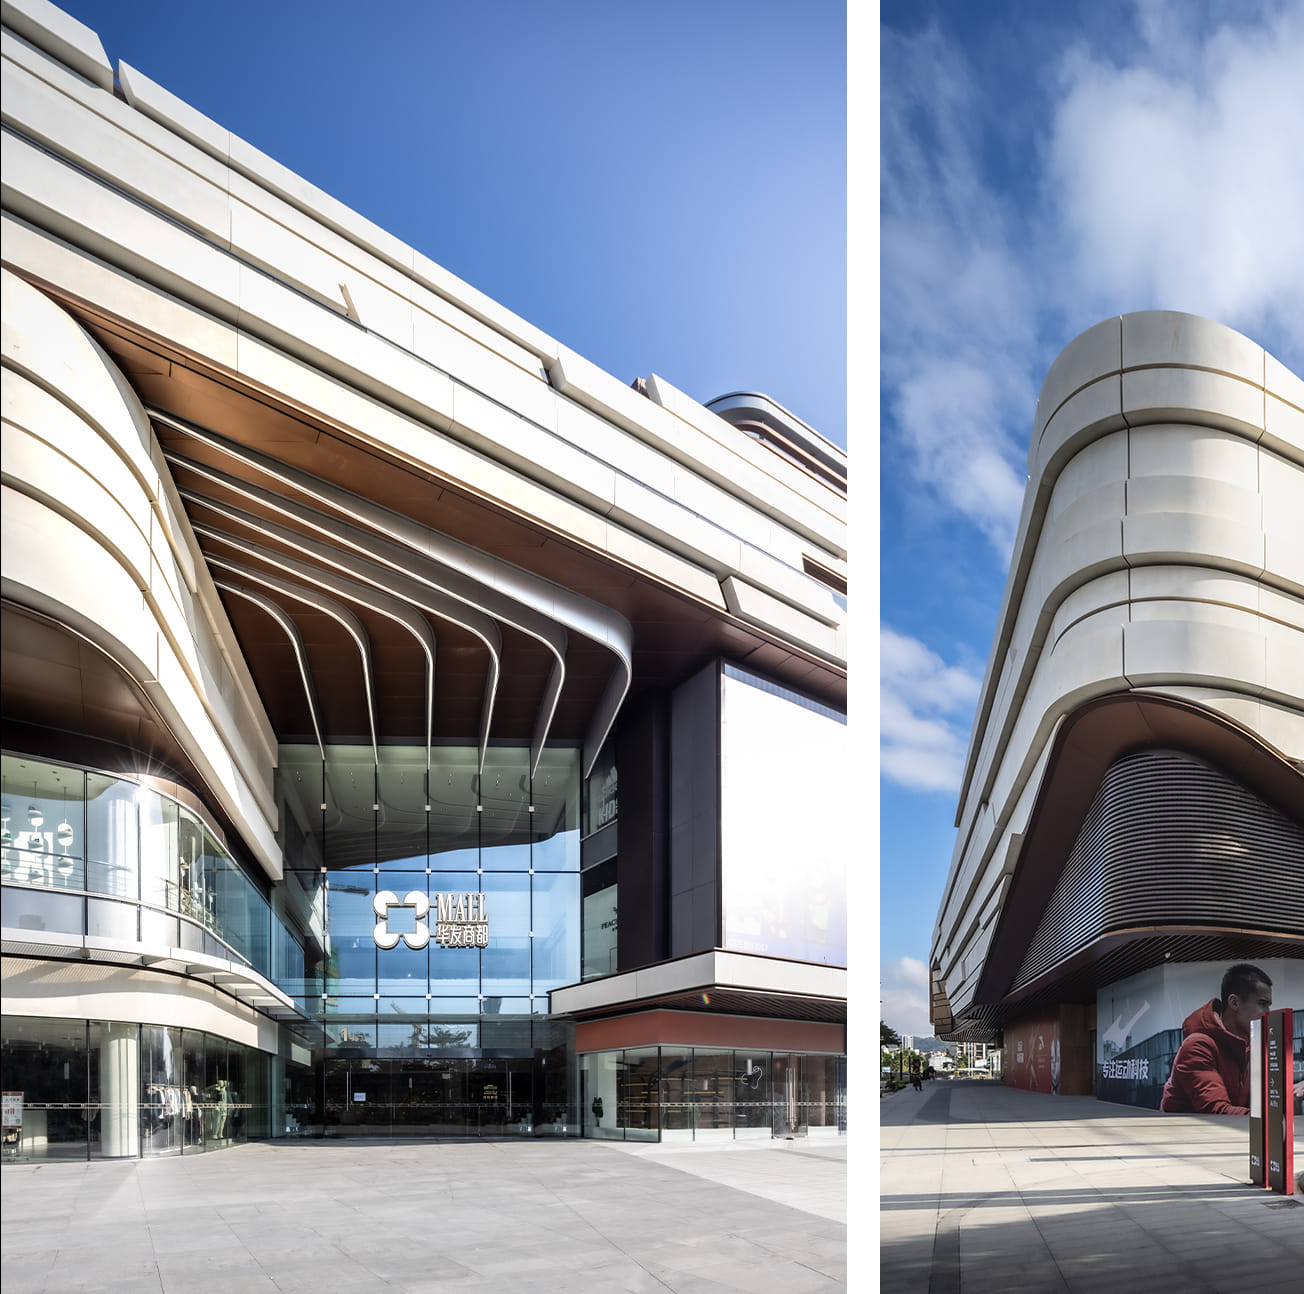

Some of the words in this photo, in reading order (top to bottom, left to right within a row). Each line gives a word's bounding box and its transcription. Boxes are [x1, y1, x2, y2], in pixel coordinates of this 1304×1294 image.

[436, 893, 488, 922] MALL
[437, 925, 488, 945] 华发商都
[1102, 1059, 1149, 1080] 专注运动科技
